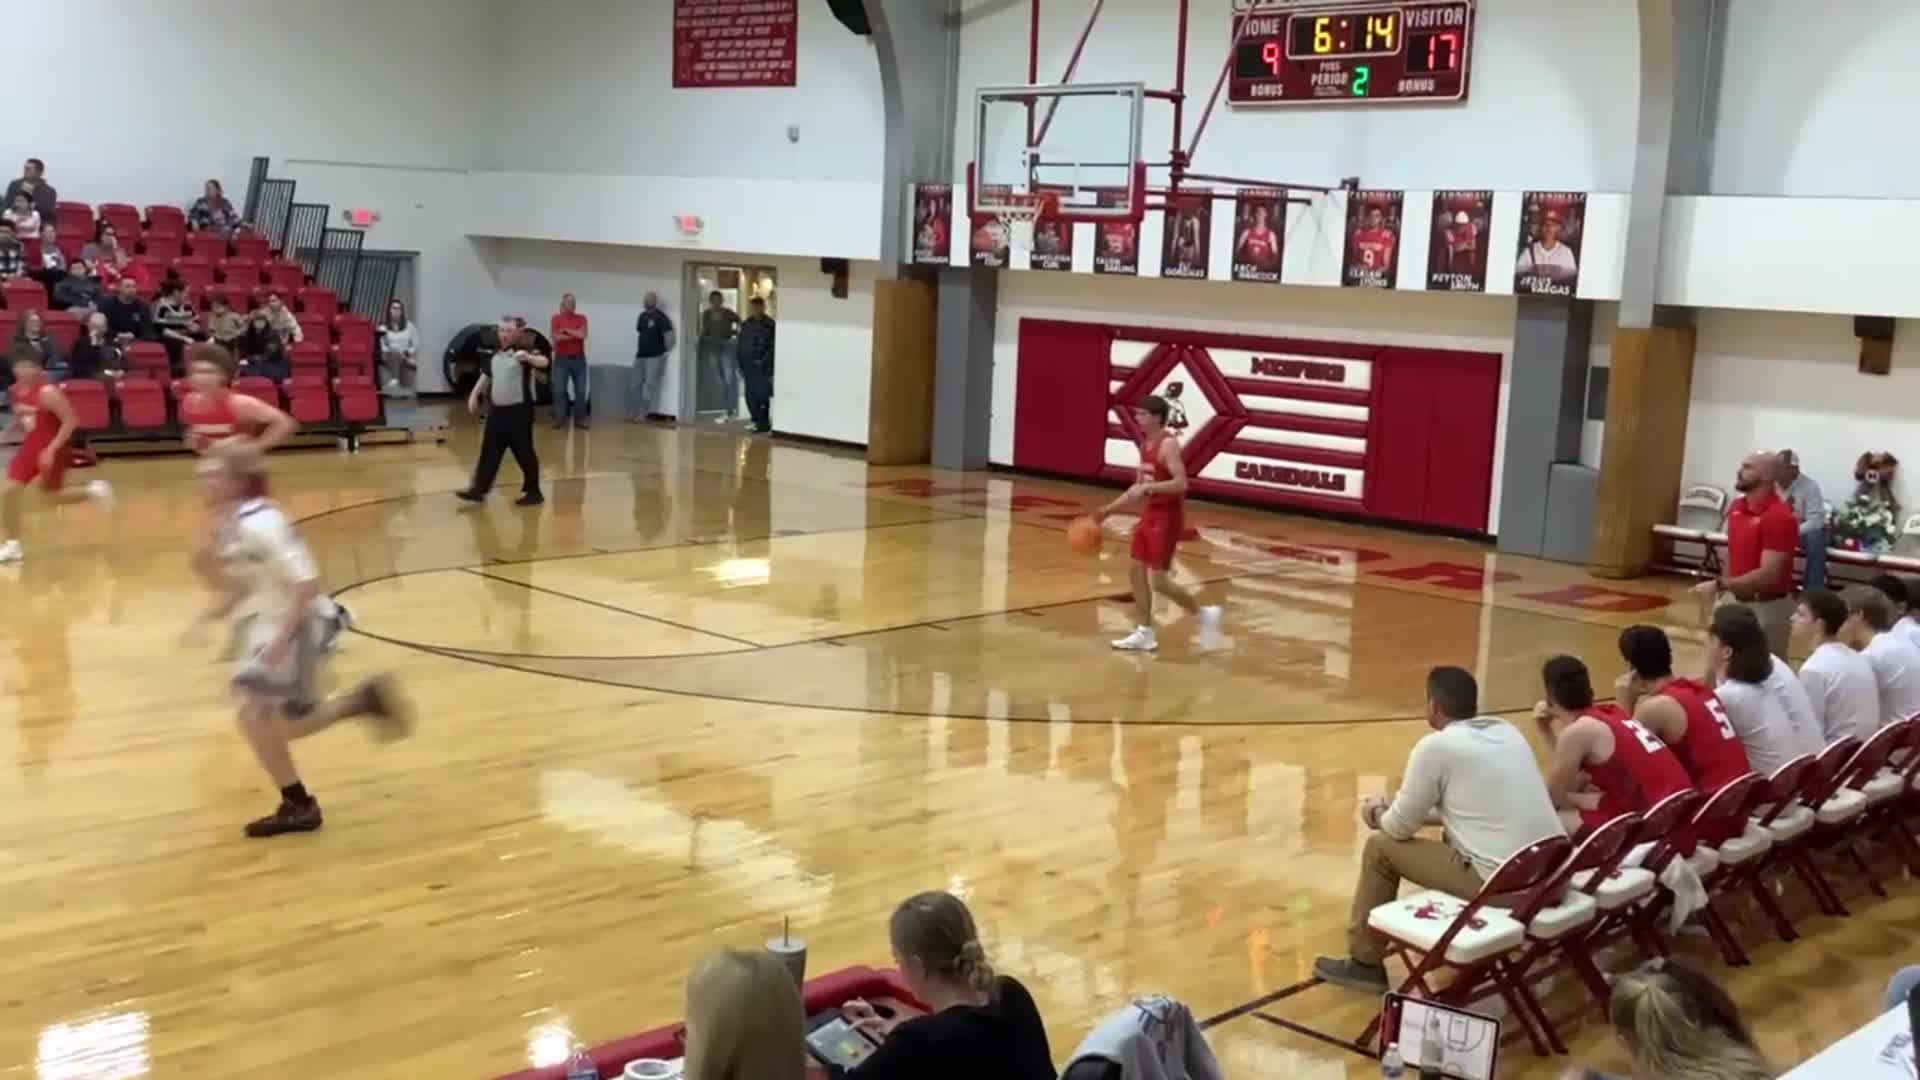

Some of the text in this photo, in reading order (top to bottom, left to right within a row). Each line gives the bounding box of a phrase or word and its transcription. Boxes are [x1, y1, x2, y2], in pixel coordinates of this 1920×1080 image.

[1405, 7, 1464, 27] VISITOR
[1314, 15, 1393, 53] 6:14
[1263, 43, 1279, 75] 9
[1428, 34, 1456, 69] 17
[1250, 84, 1283, 97] BONUS
[1311, 72, 1348, 86] PERIOD
[1352, 66, 1369, 96] 2
[1397, 79, 1435, 93] BONUS
[1704, 697, 1737, 740] 5
